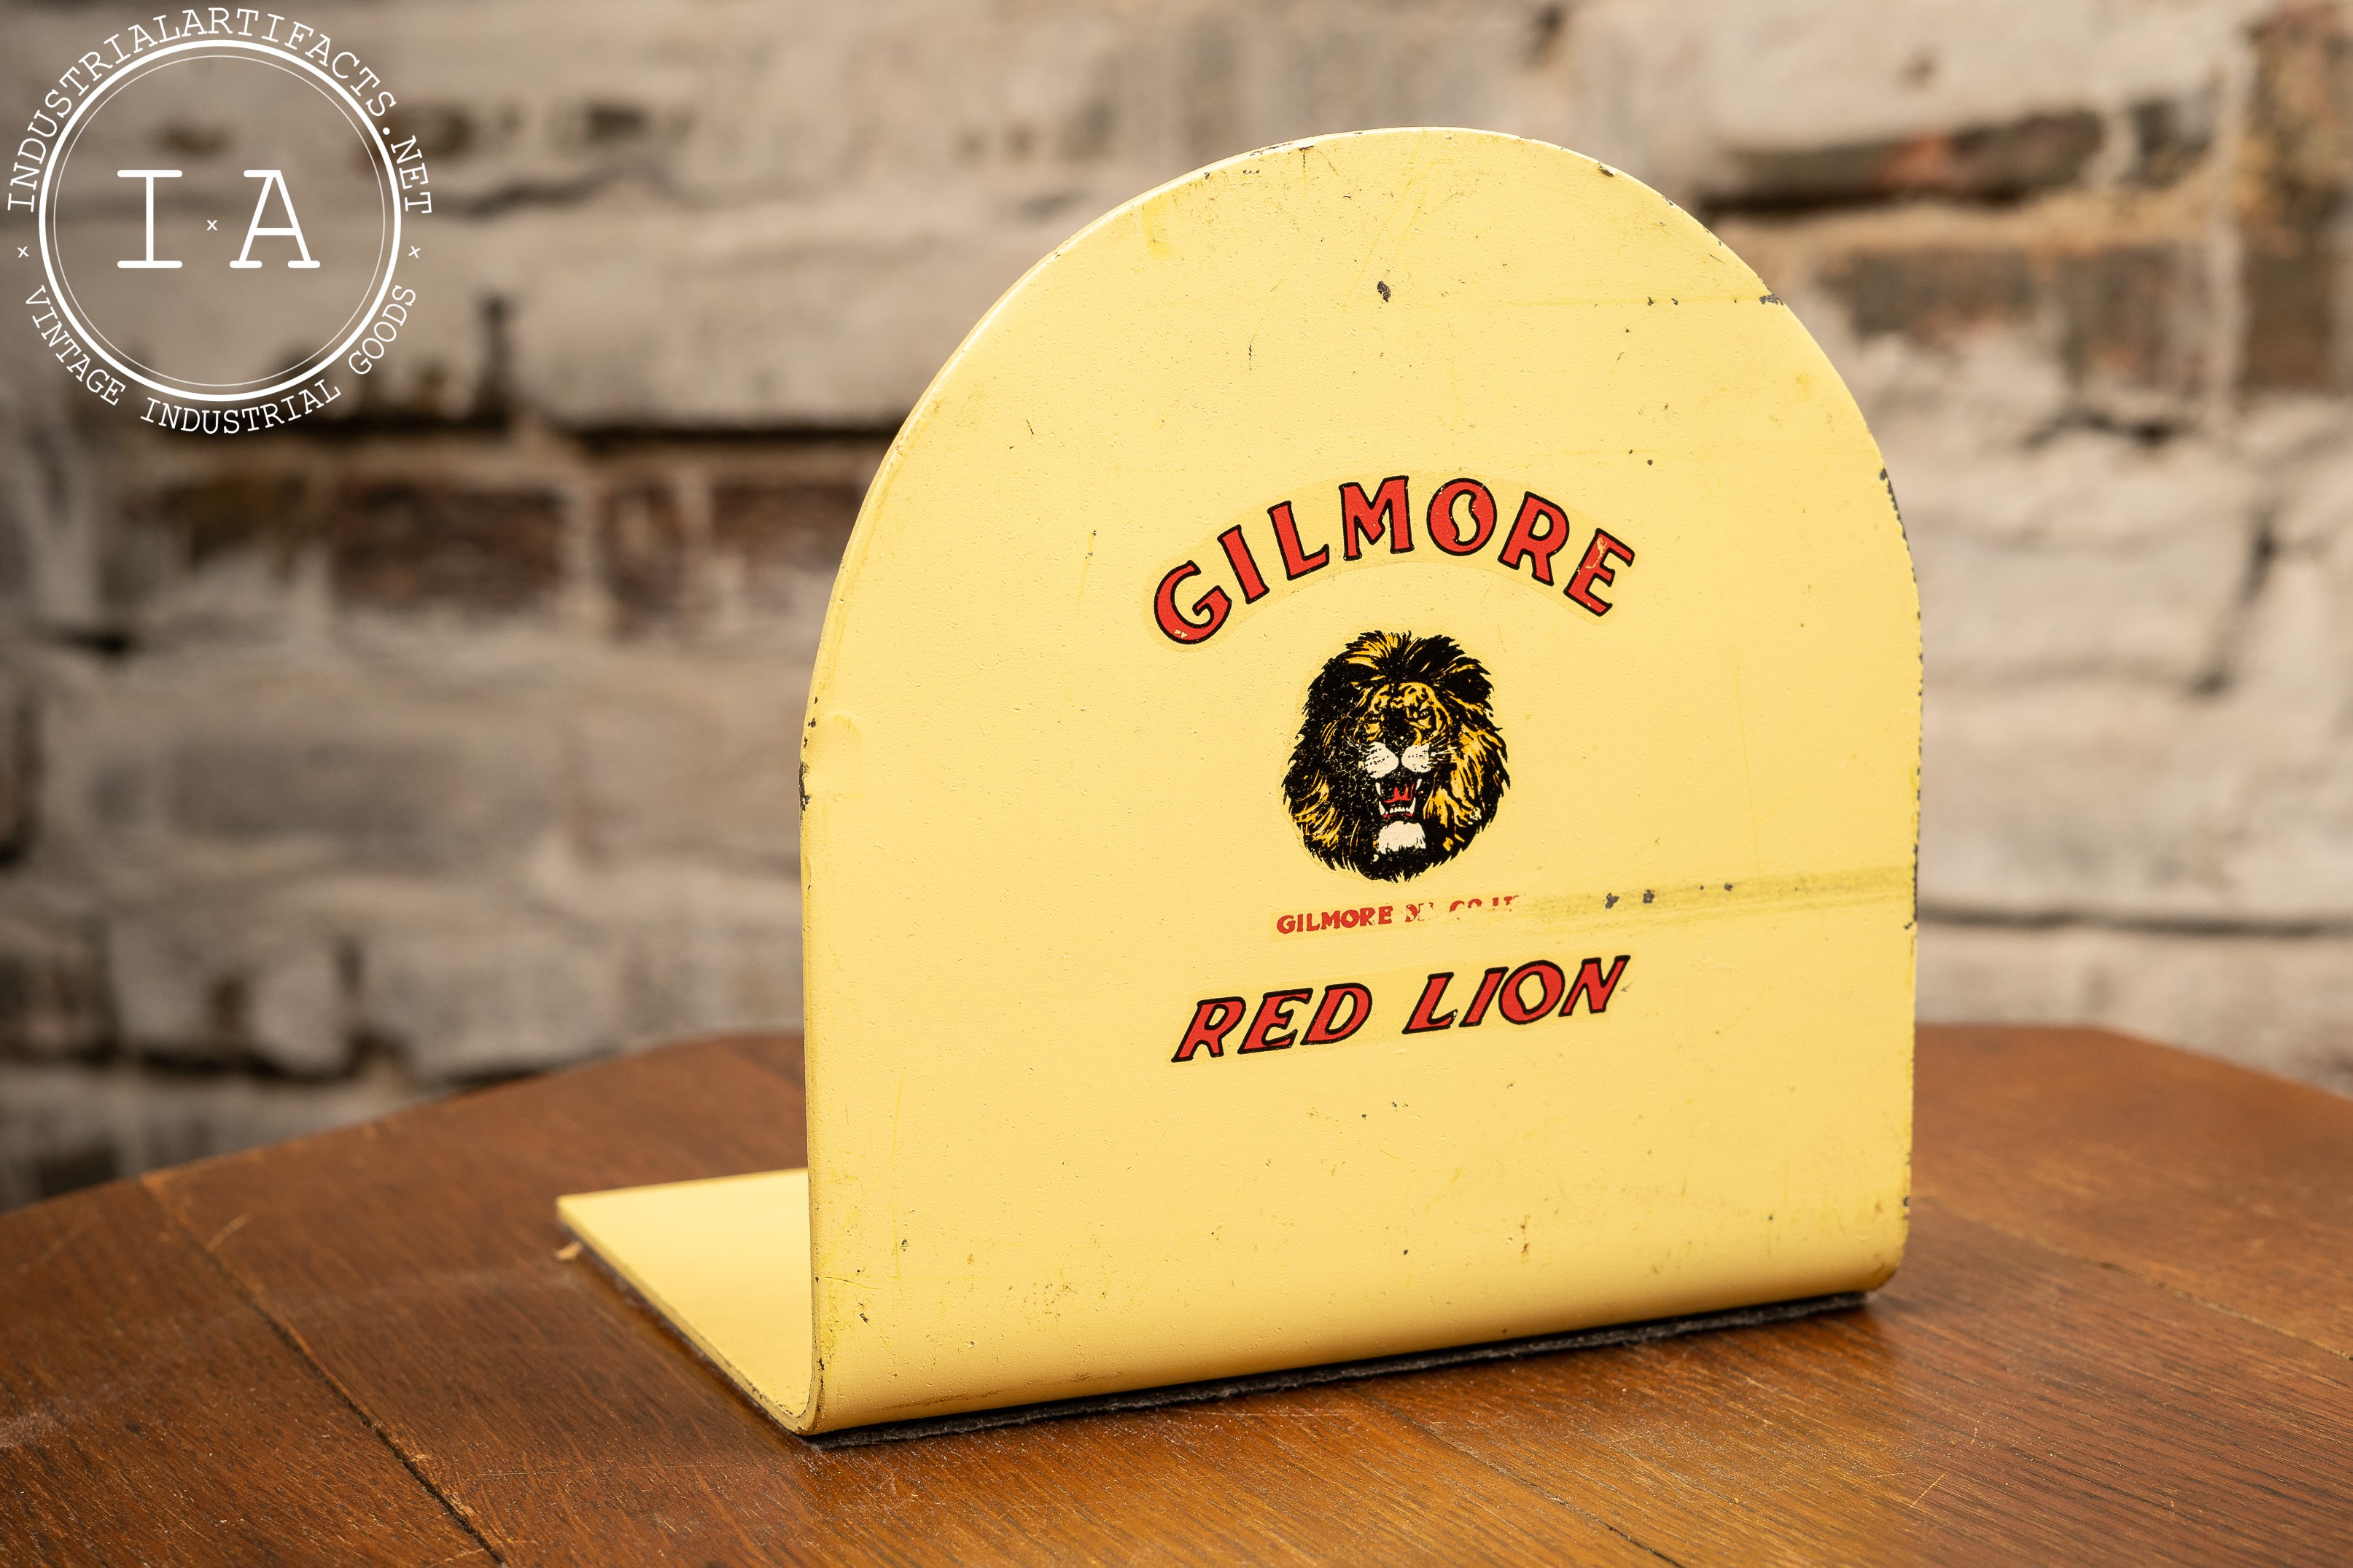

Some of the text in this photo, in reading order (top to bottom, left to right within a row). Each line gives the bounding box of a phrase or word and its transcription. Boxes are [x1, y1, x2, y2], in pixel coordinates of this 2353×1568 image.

[1154, 475, 1636, 645] GILMORE
[1276, 905, 1393, 935] GILMORE
[1171, 954, 1631, 1063] RED LION
